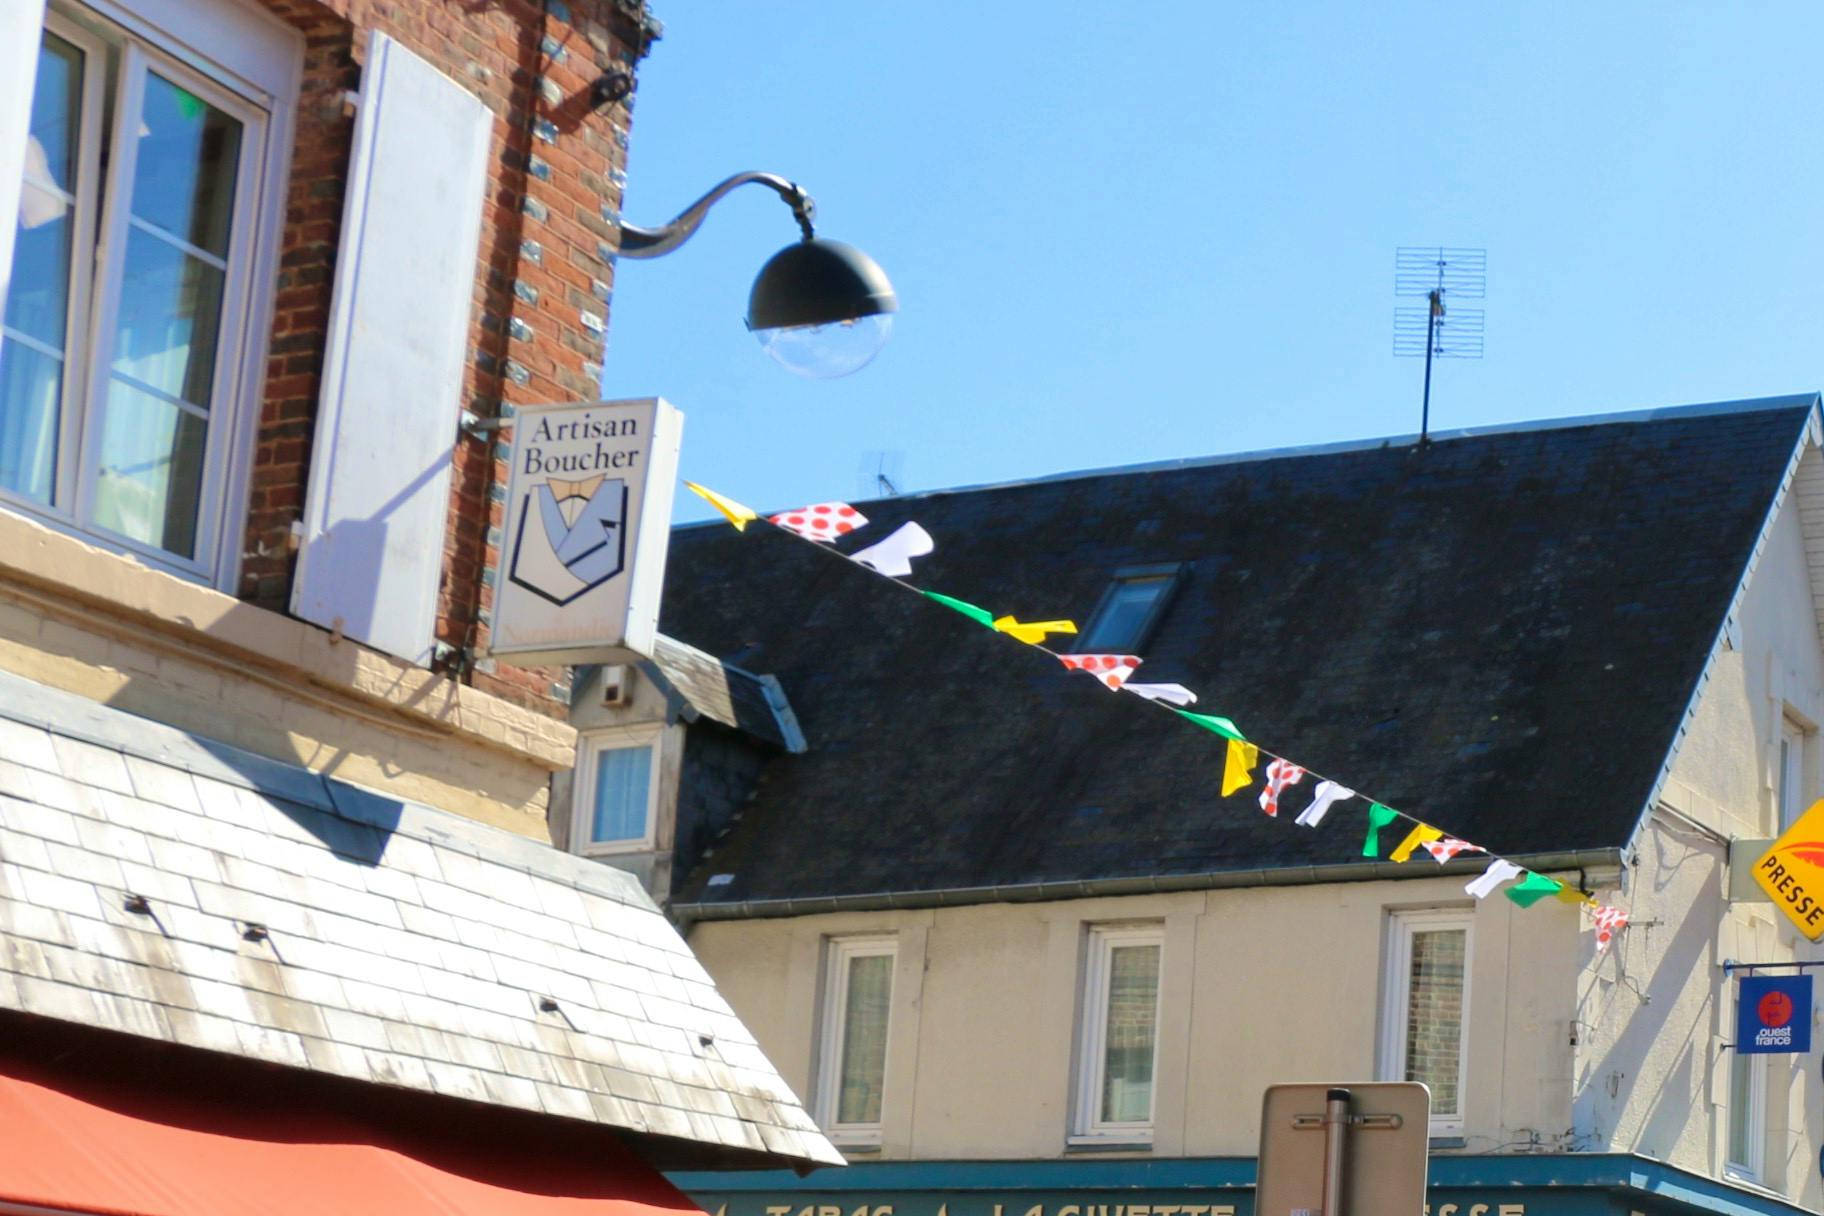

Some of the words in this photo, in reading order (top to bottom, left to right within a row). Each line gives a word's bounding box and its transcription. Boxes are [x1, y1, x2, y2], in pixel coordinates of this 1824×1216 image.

[531, 413, 637, 443] Artisan
[524, 443, 640, 475] Boucher
[1755, 1034, 1792, 1046] france
[1759, 1025, 1792, 1037] ouest
